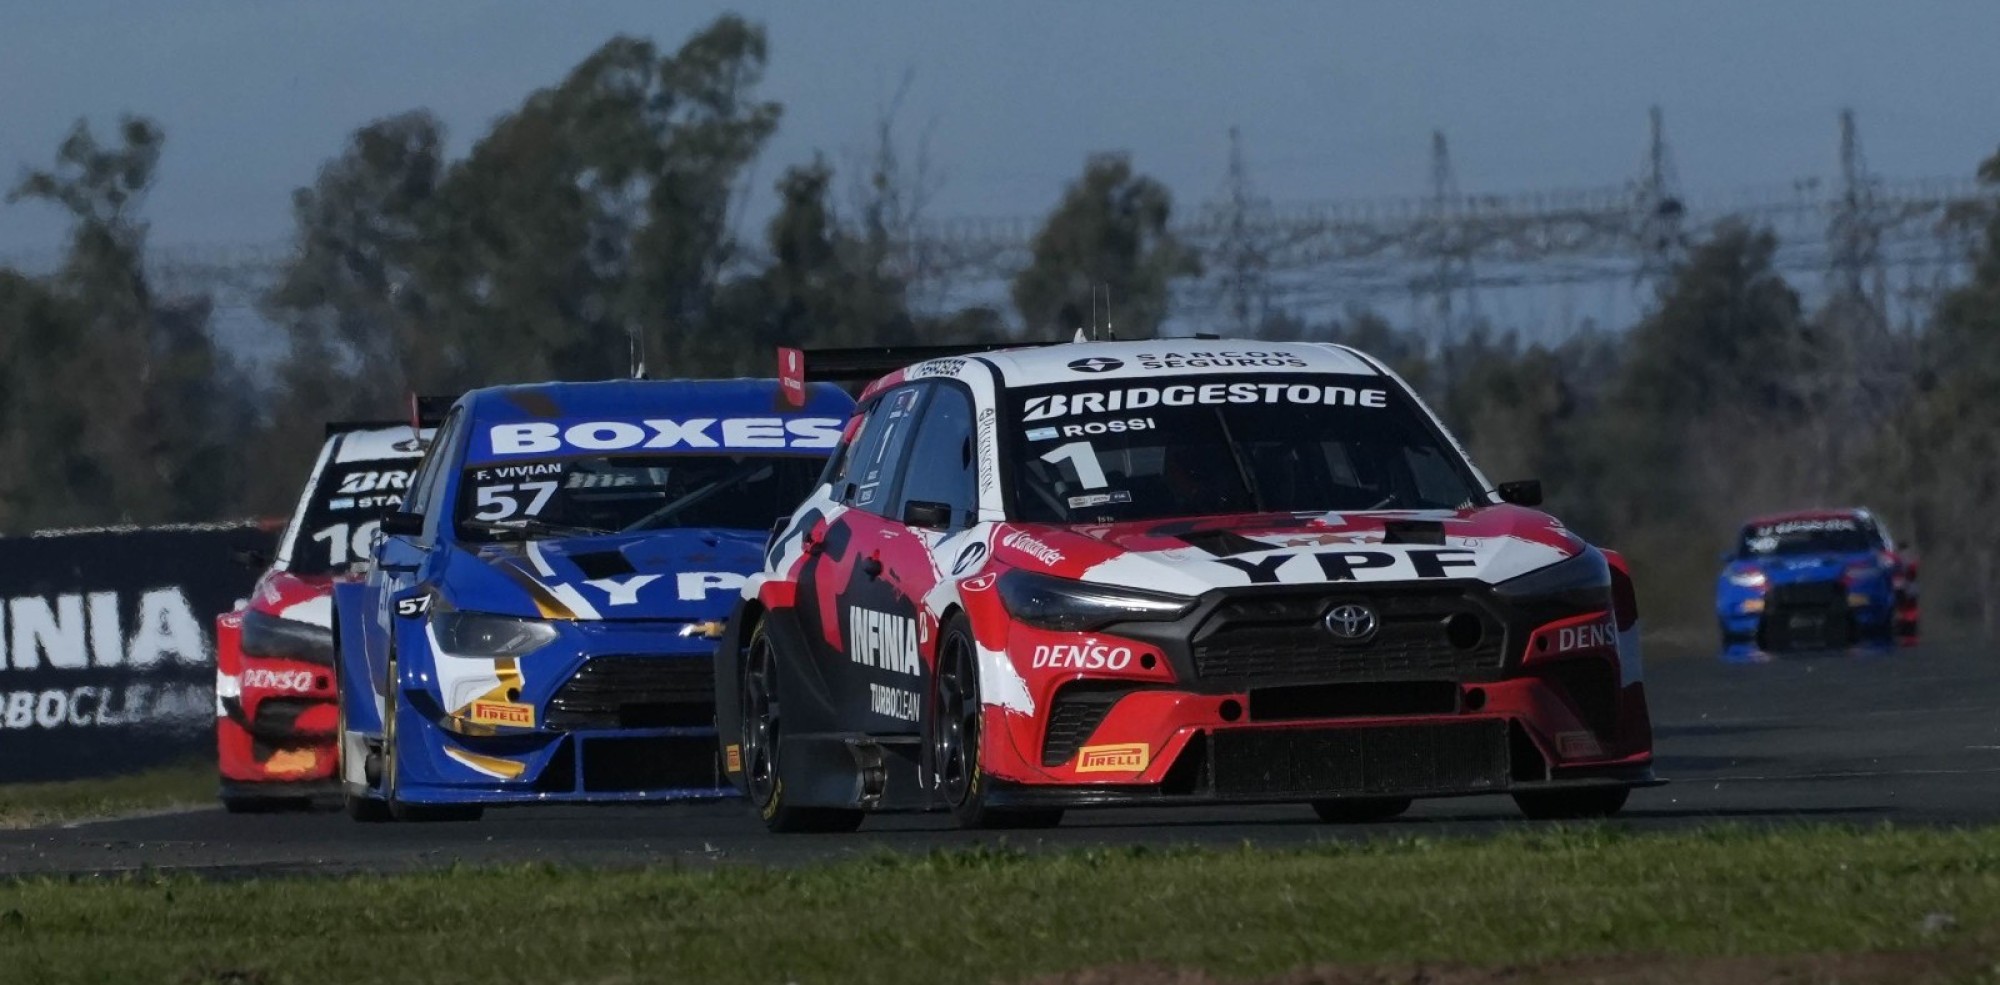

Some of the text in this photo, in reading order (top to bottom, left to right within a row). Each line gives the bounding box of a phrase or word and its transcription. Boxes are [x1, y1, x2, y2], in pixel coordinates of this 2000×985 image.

[1136, 351, 1296, 361] SANCOR
[1141, 358, 1308, 369] SEGUROS
[1022, 382, 1387, 422] BRIDGESTONE
[490, 417, 844, 455] BOXES
[1062, 417, 1156, 437] ROSSI
[476, 463, 562, 481] F. VIVIAN
[1039, 441, 1109, 490] 1
[475, 481, 559, 521] 57
[1011, 531, 1066, 567] Santander
[1209, 550, 1478, 584] YPF
[398, 593, 431, 615] 57
[0, 586, 208, 671] NIA
[850, 605, 921, 677] INFINIA
[1031, 645, 1132, 671] DENSO
[244, 669, 313, 692] DENSO
[476, 703, 529, 723] PIRELLI
[869, 683, 921, 722] TURBOCLEAN
[1081, 748, 1142, 768] PIRELLI
